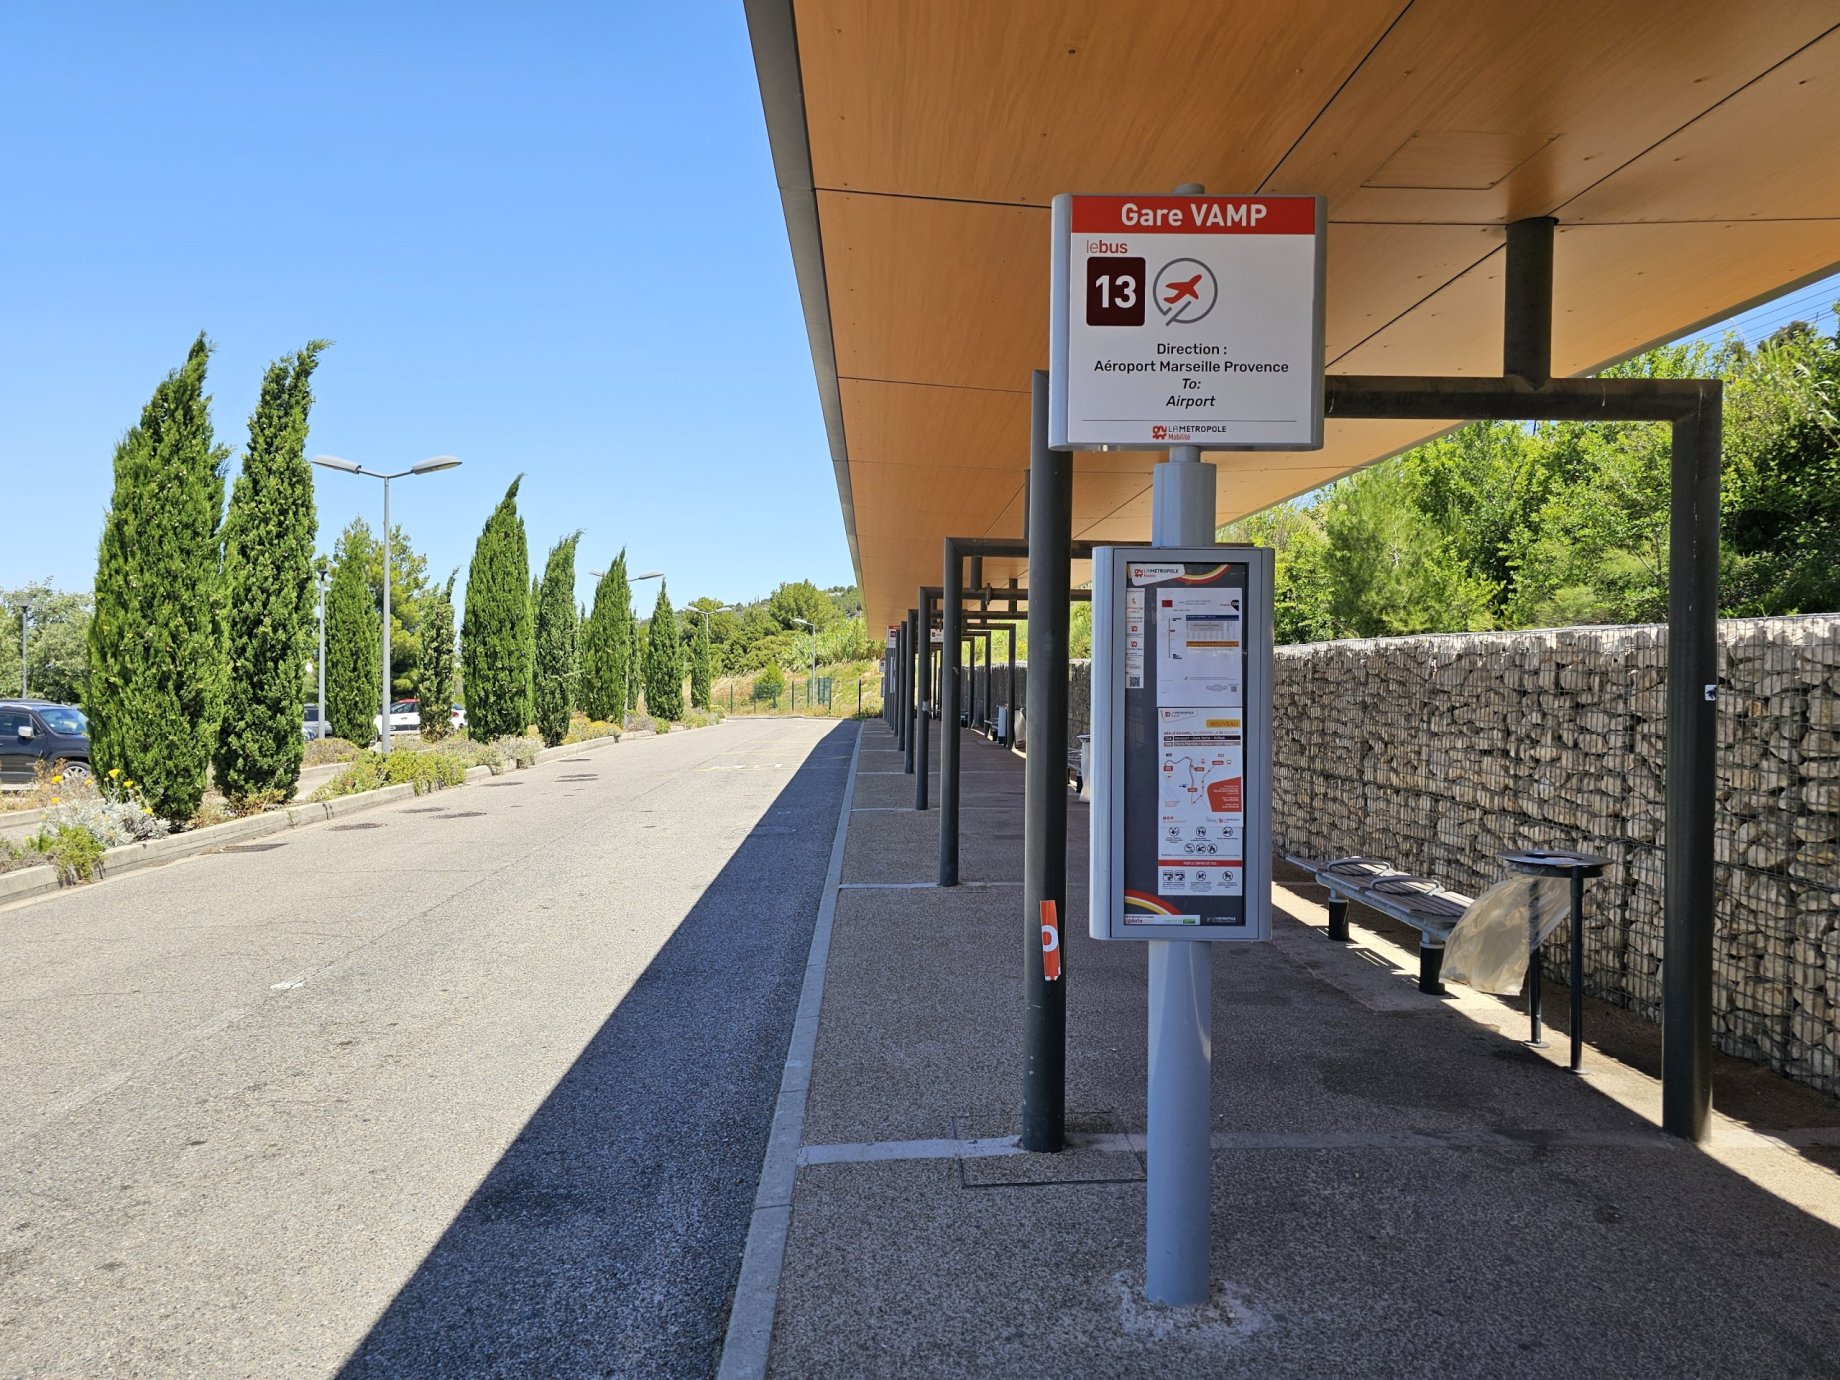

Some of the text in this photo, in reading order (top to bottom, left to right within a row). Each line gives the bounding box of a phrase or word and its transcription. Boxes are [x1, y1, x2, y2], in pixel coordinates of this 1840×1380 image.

[1121, 203, 1267, 227] Gare VAMP
[1086, 239, 1128, 254] lebus
[1095, 274, 1137, 309] 13
[1156, 343, 1220, 355] Direction
[1094, 360, 1289, 374] Aéroport Marseille Provence
[1182, 377, 1202, 390] To:
[1165, 395, 1216, 409] Airport
